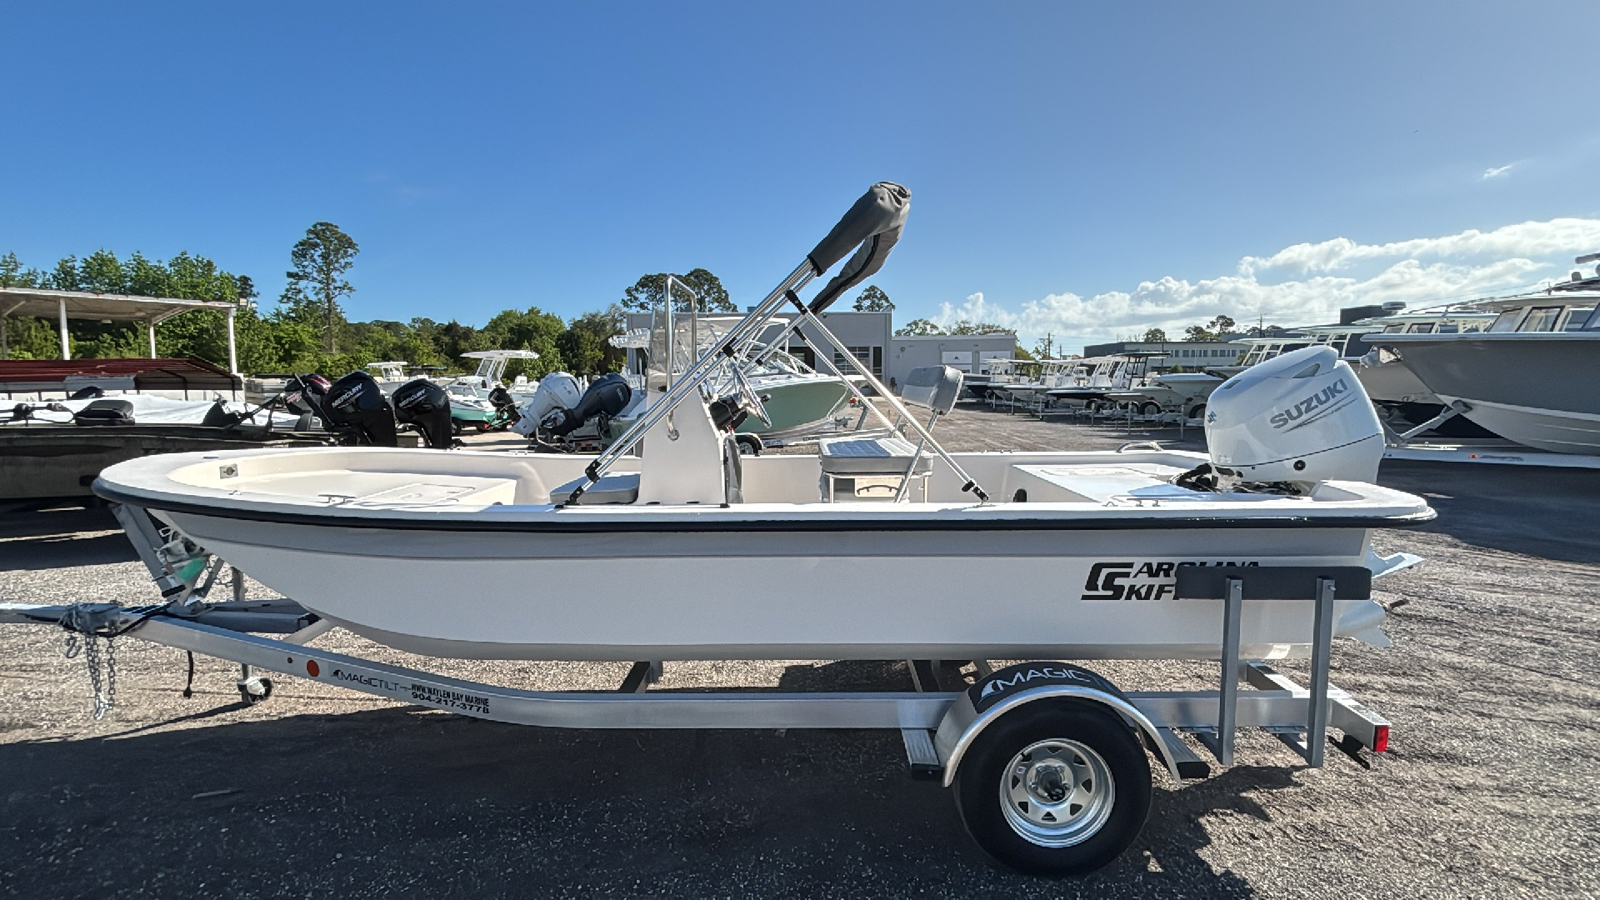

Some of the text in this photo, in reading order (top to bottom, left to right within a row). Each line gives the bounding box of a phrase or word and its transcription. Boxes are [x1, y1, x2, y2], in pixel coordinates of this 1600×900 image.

[331, 383, 363, 408] MERCURY
[398, 388, 426, 408] MERCURY
[1269, 378, 1348, 429] SUZUKI
[1081, 571, 1180, 600] SKIF
[340, 670, 399, 691] MAGICTILT
[411, 691, 490, 714] 904-217-3778
[451, 691, 464, 702] BAY
[464, 694, 490, 707] MARINE
